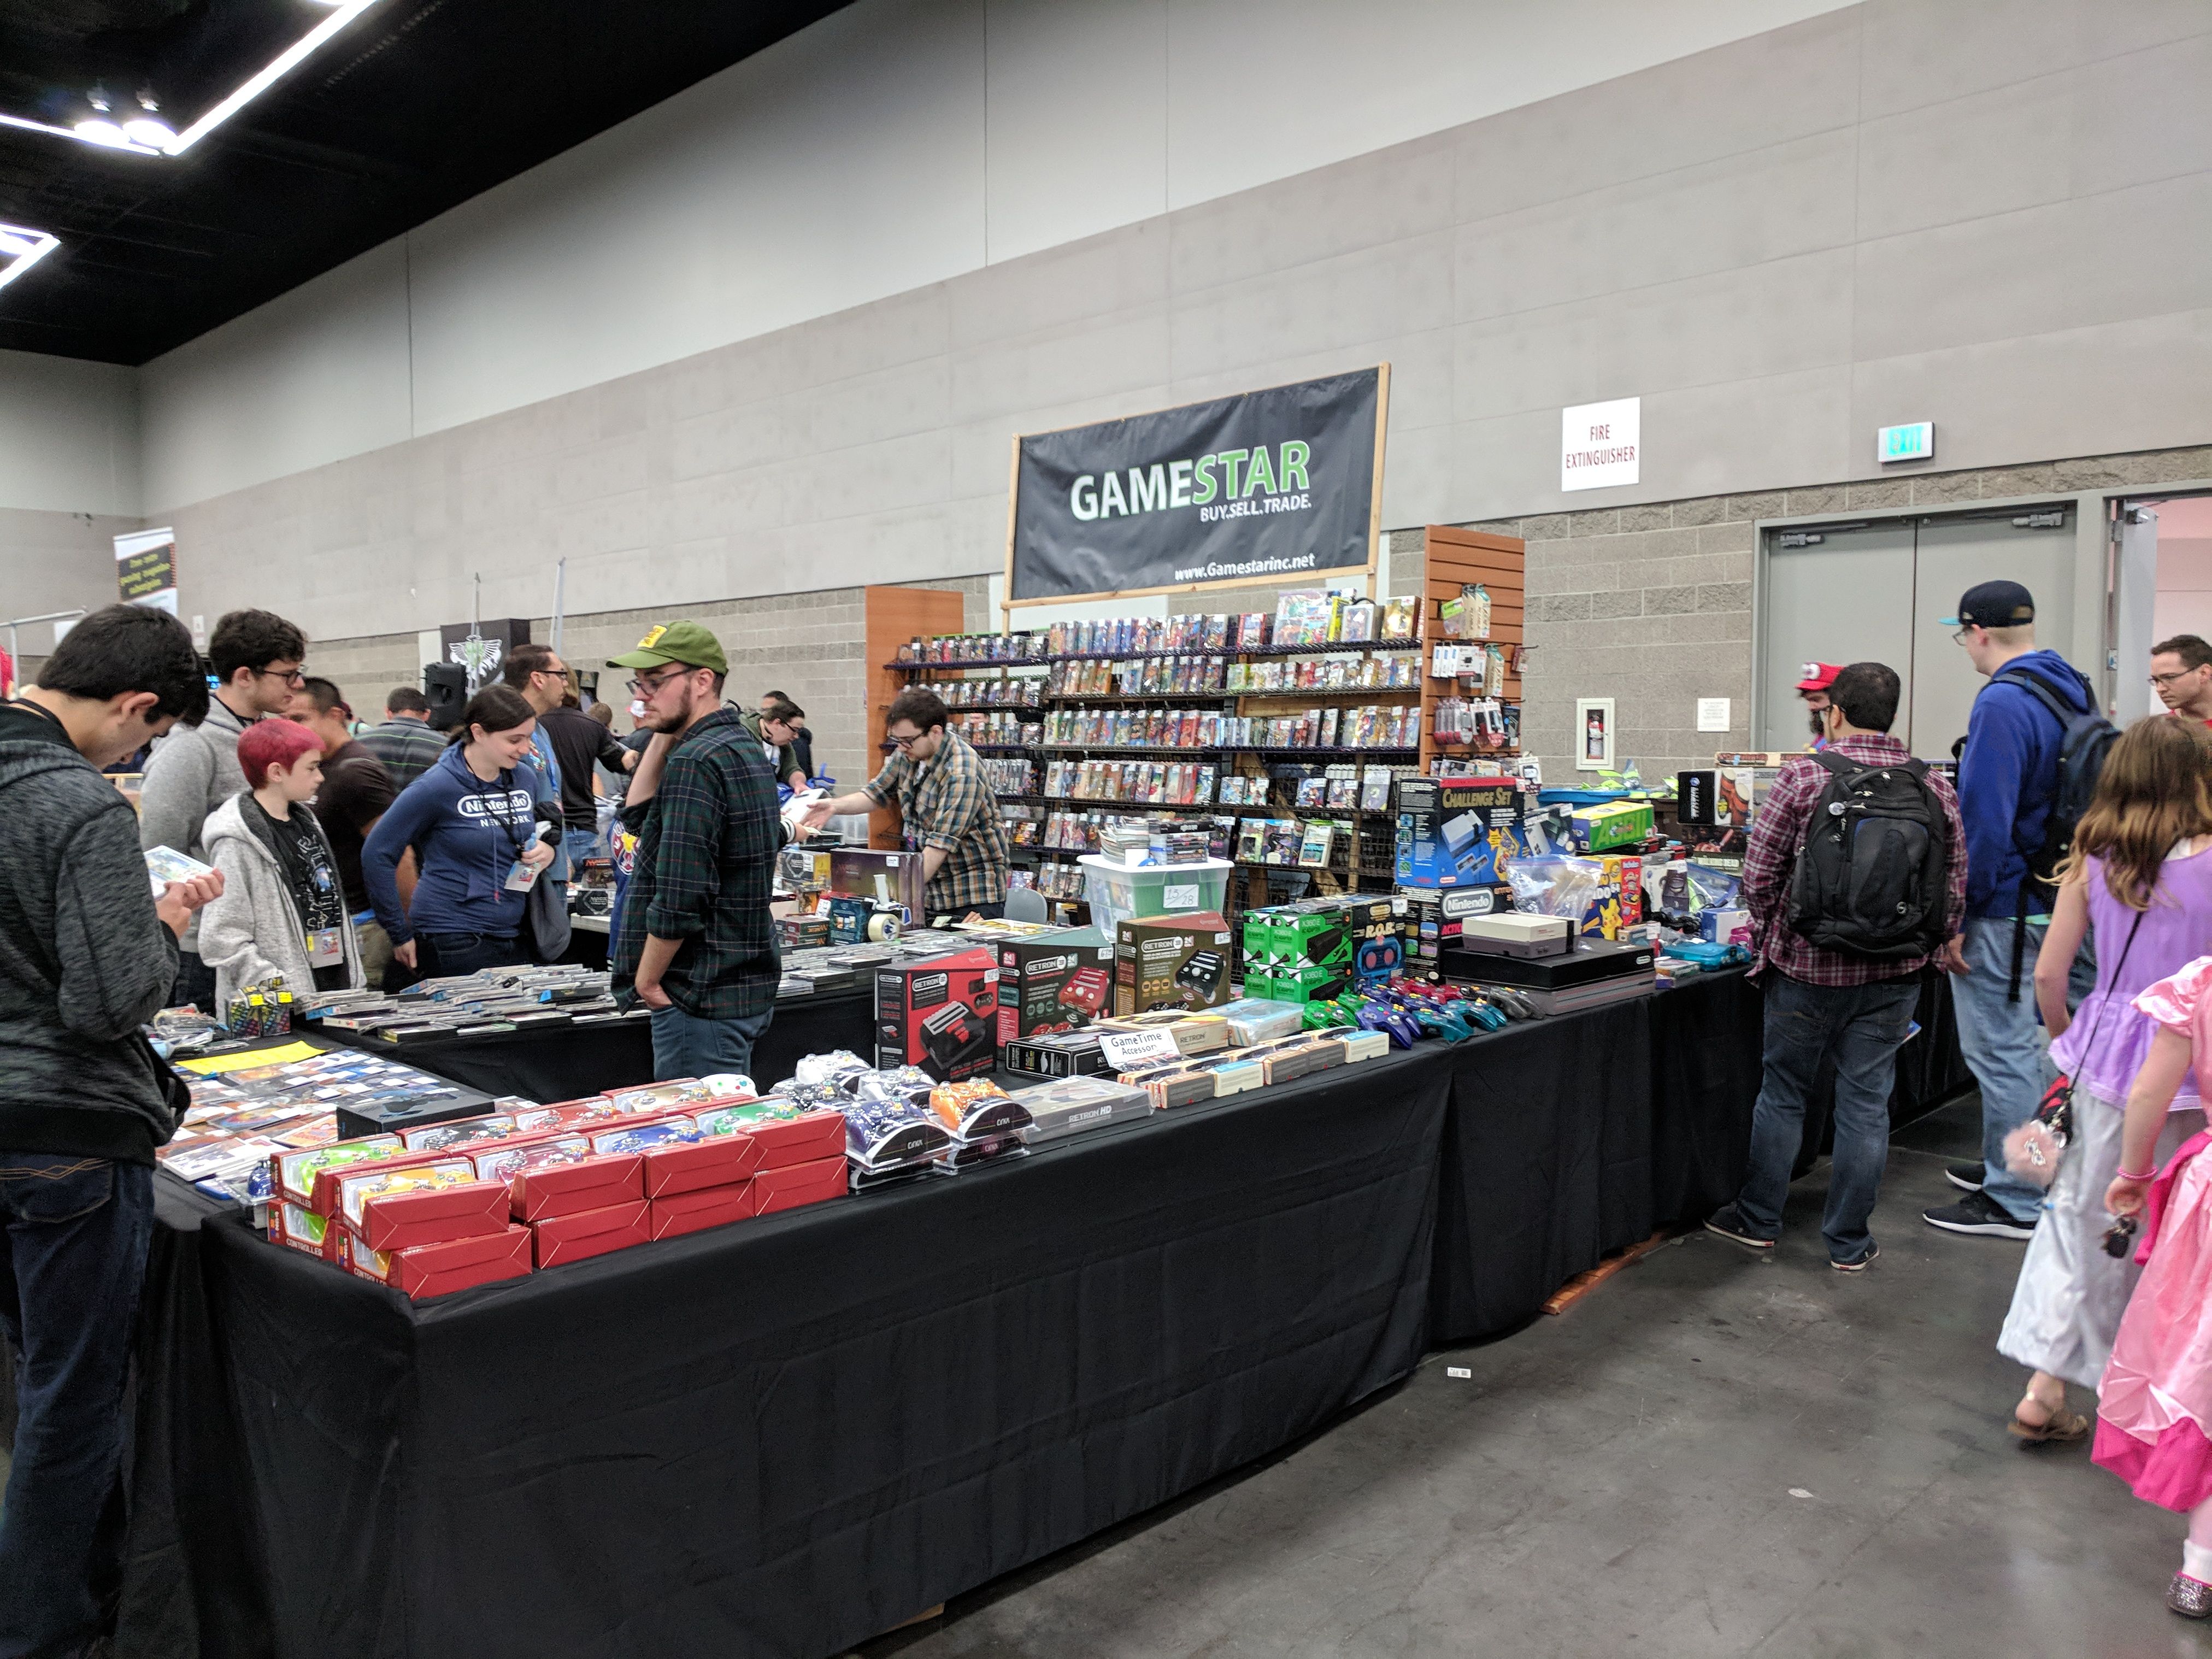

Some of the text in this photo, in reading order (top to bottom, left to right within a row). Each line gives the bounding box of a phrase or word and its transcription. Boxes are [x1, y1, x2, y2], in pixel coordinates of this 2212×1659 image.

[1590, 424, 1610, 441] FIRE
[1886, 426, 1923, 456] EXIT
[1566, 446, 1635, 468] EXTINGUISHER
[1070, 440, 1310, 521] GAMESTAR
[1200, 494, 1311, 522] BUY.SELL.TRADE.
[1175, 552, 1315, 581] www.Gamestarinc.net
[1442, 788, 1495, 808] CHALLENGE
[1495, 787, 1513, 805] SET
[1181, 895, 1194, 905] 28
[1448, 895, 1490, 911] Nintendo
[1143, 940, 1173, 950] RETRON
[1028, 960, 1057, 972] RETRON
[914, 978, 939, 989] RETRON
[1111, 1032, 1162, 1047] GameTime
[1180, 1034, 1205, 1043] RETRON
[1068, 1105, 1113, 1122] RETRON HD
[286, 1238, 323, 1257] CONTROLLER
